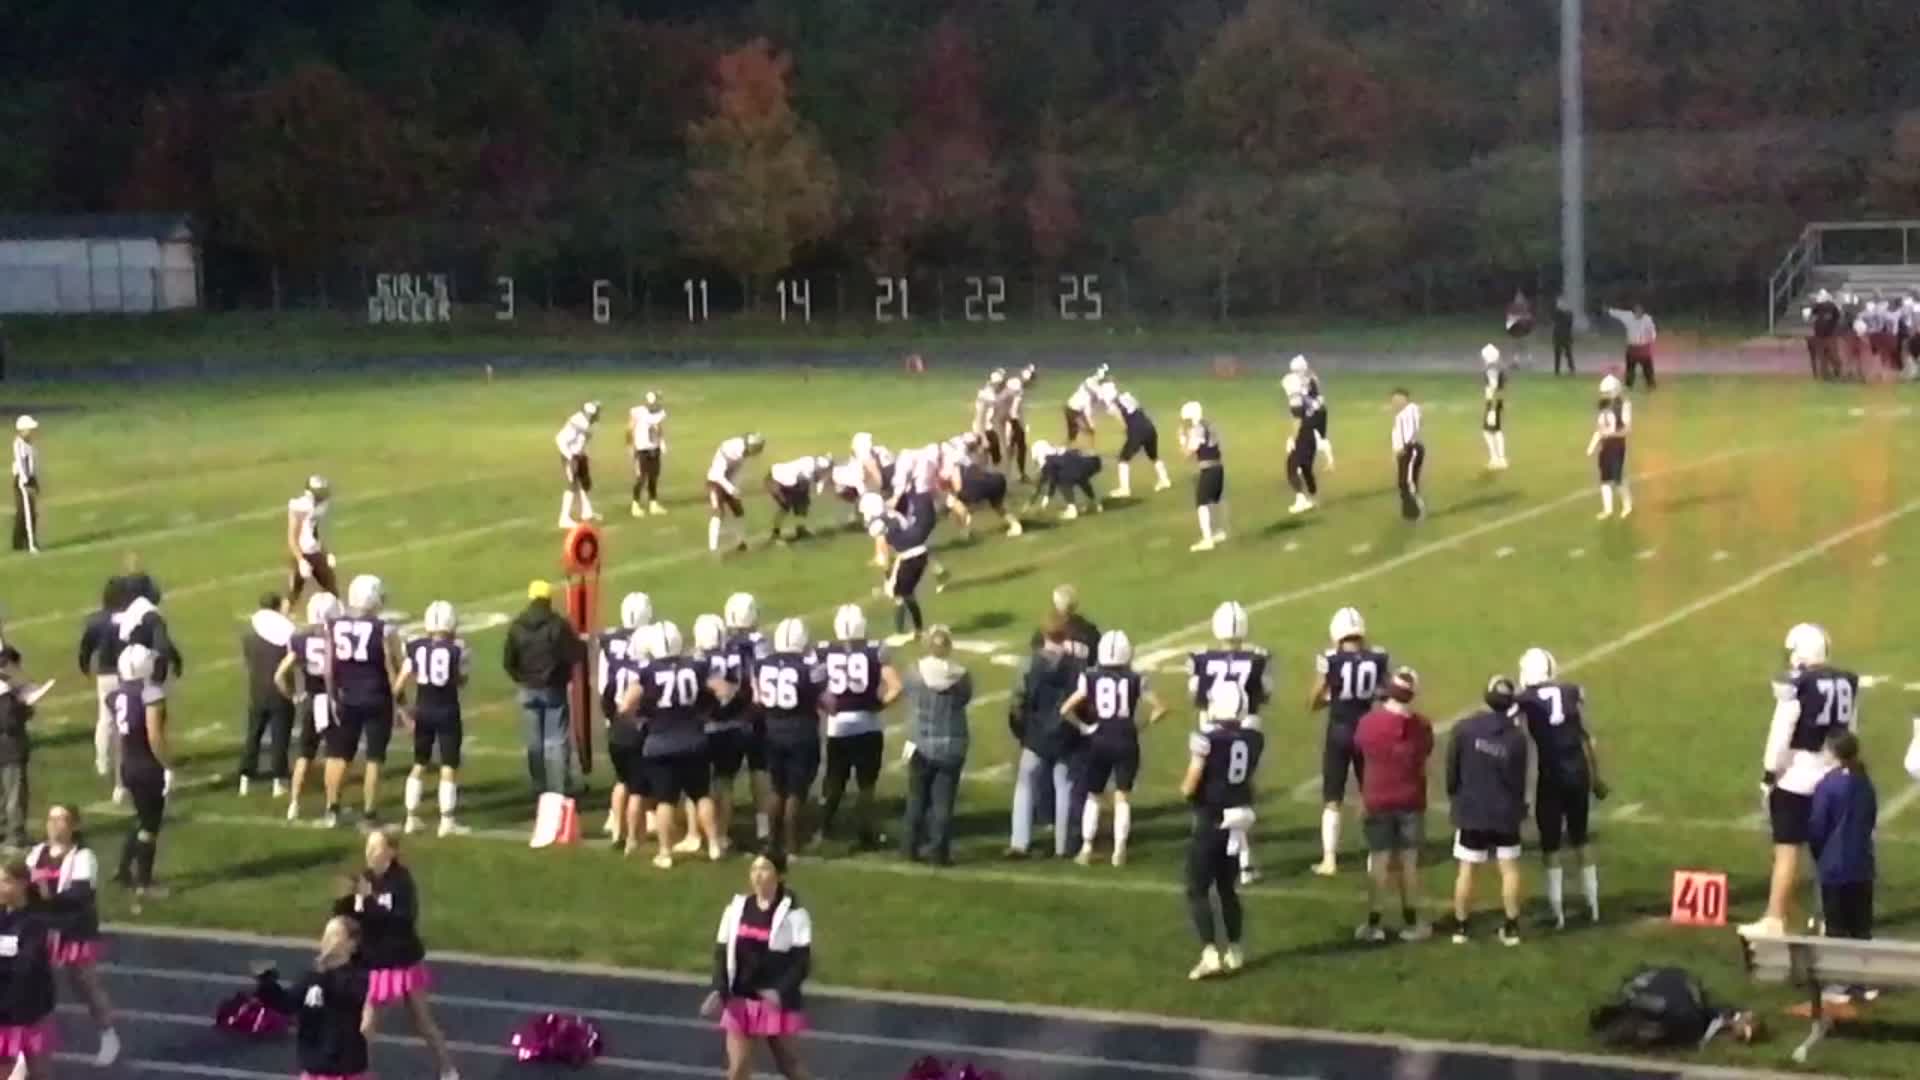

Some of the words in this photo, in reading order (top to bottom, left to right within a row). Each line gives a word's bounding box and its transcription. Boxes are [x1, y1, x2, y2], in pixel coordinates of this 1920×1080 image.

[496, 277, 513, 319] 3
[593, 279, 611, 323] 6
[683, 279, 708, 321] 11
[776, 279, 809, 324] 14
[875, 277, 909, 321] 21
[965, 276, 1005, 320] 22
[1060, 275, 1101, 320] 25
[305, 636, 327, 676] 5
[334, 620, 373, 662] 57
[415, 645, 450, 686] 18
[760, 664, 799, 709] 56
[826, 652, 869, 694] 59
[1340, 660, 1377, 700] 10
[655, 667, 698, 708] 70
[1095, 677, 1129, 719] 81
[1537, 686, 1565, 726] 7
[1815, 678, 1852, 725] 78
[1228, 739, 1248, 784] 8
[1678, 877, 1721, 920] 40
